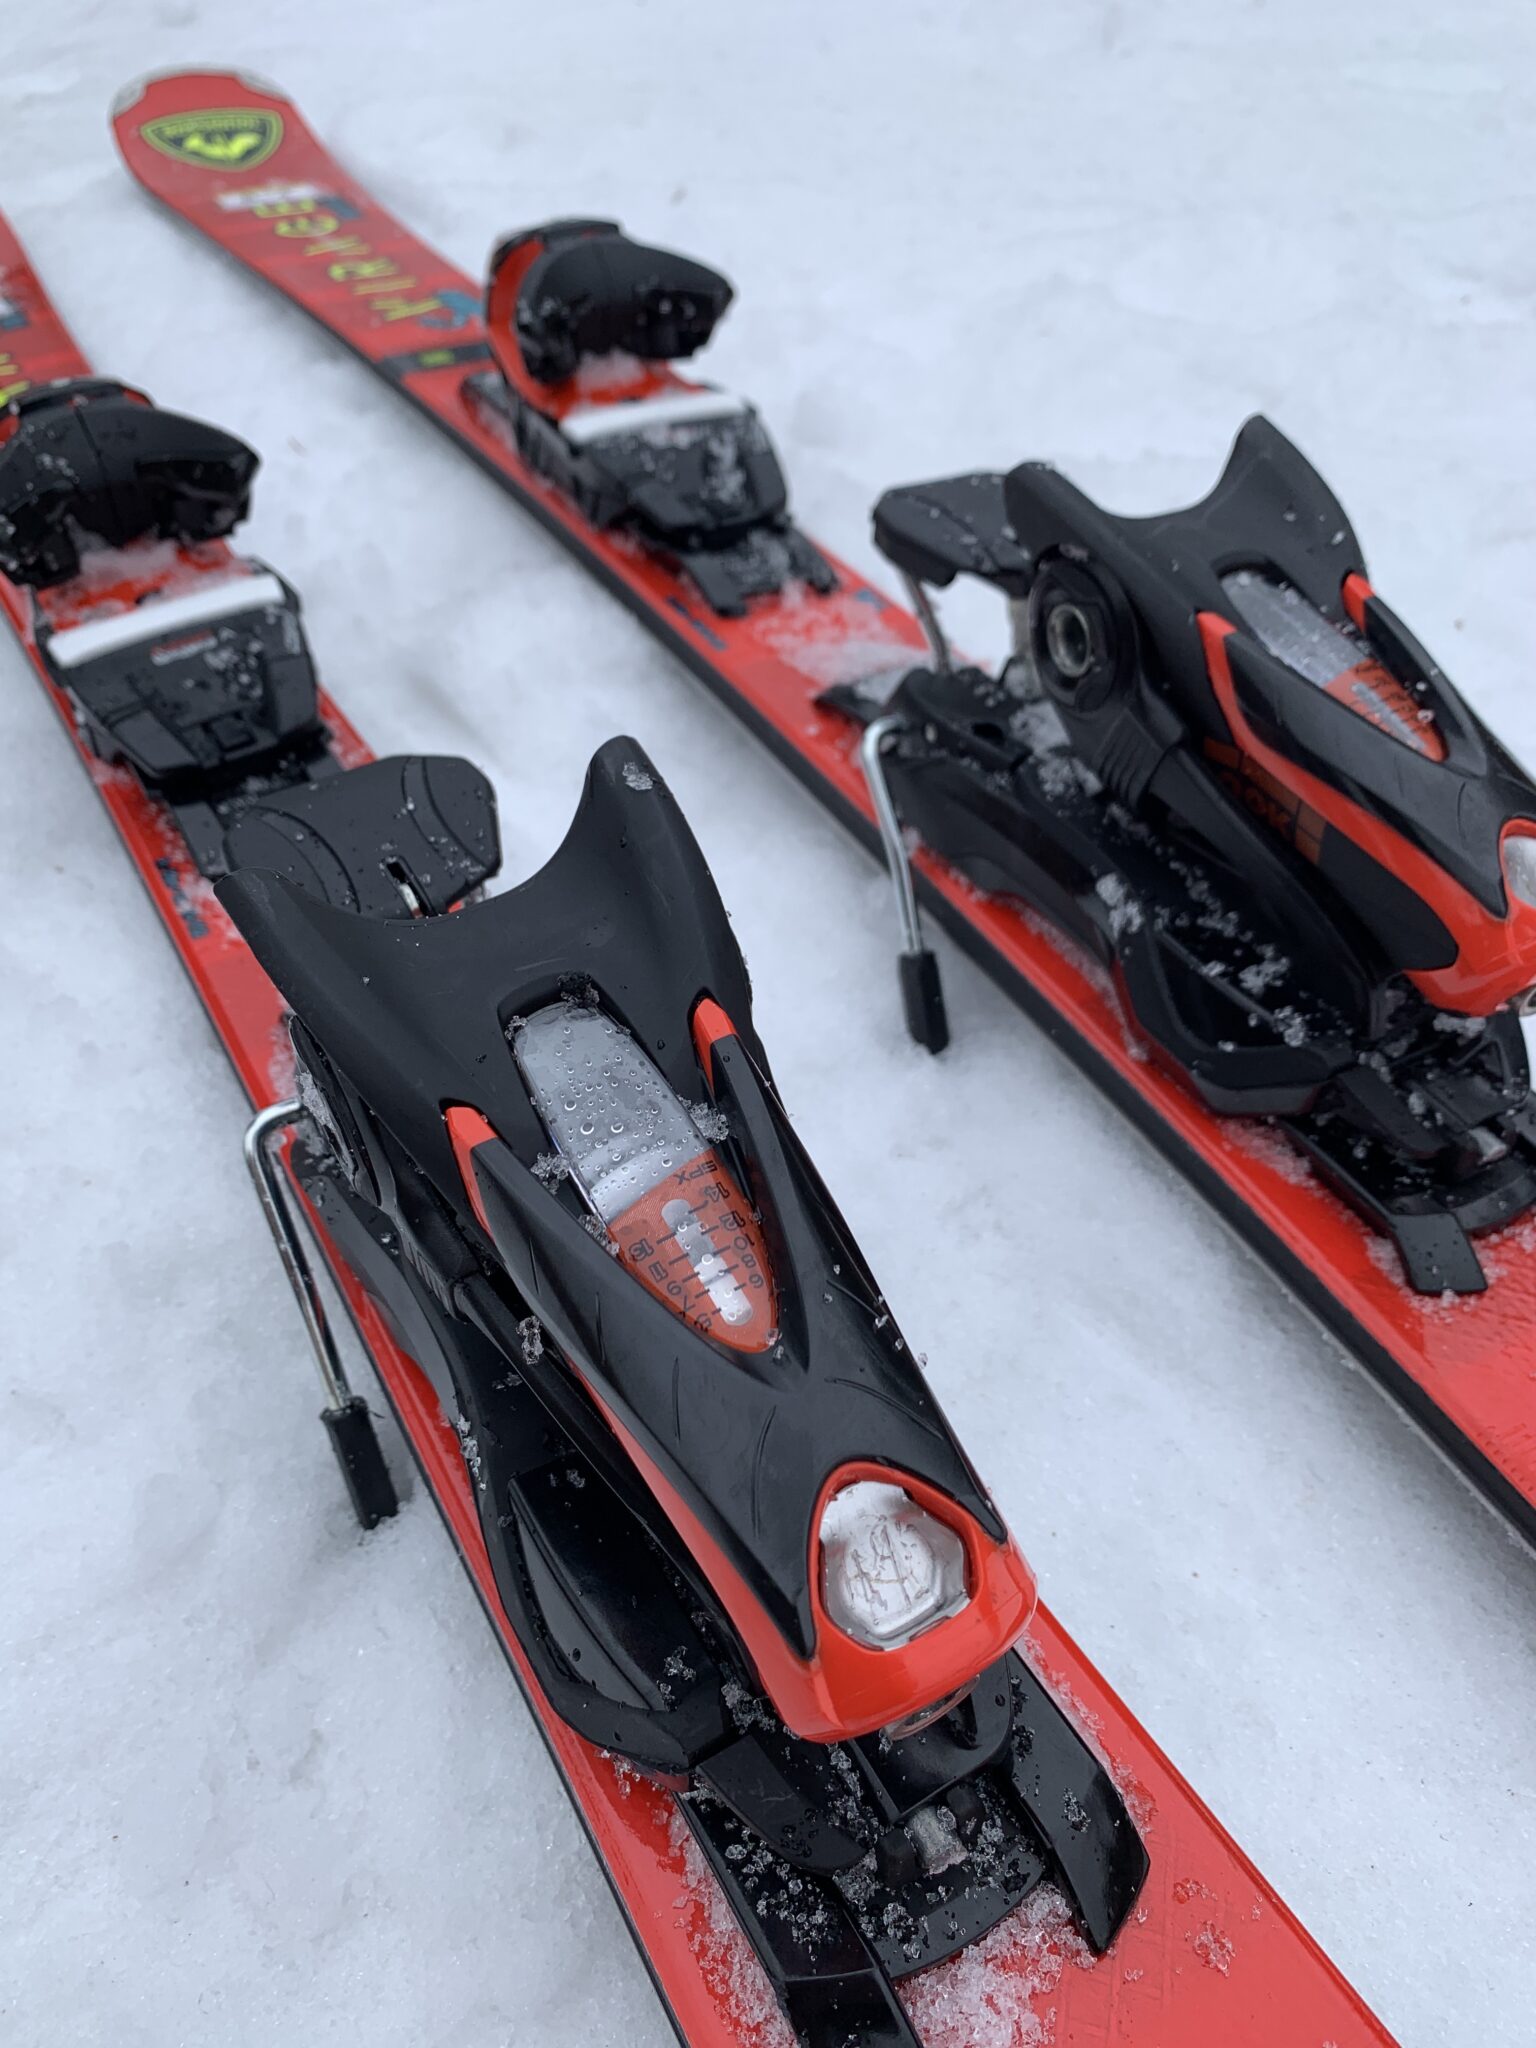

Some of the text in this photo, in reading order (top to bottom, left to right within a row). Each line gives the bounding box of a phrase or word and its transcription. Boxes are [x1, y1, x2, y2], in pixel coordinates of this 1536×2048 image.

[674, 1160, 717, 1185] SPX
[704, 1181, 730, 1202] 14
[719, 1210, 745, 1231] 12
[628, 1238, 654, 1262] 13
[734, 1233, 754, 1250] 10
[741, 1254, 756, 1268] 8
[648, 1260, 668, 1282] 11
[667, 1281, 682, 1296] 9
[749, 1274, 764, 1288] 6
[682, 1295, 696, 1312] 7
[696, 1313, 712, 1328] 5
